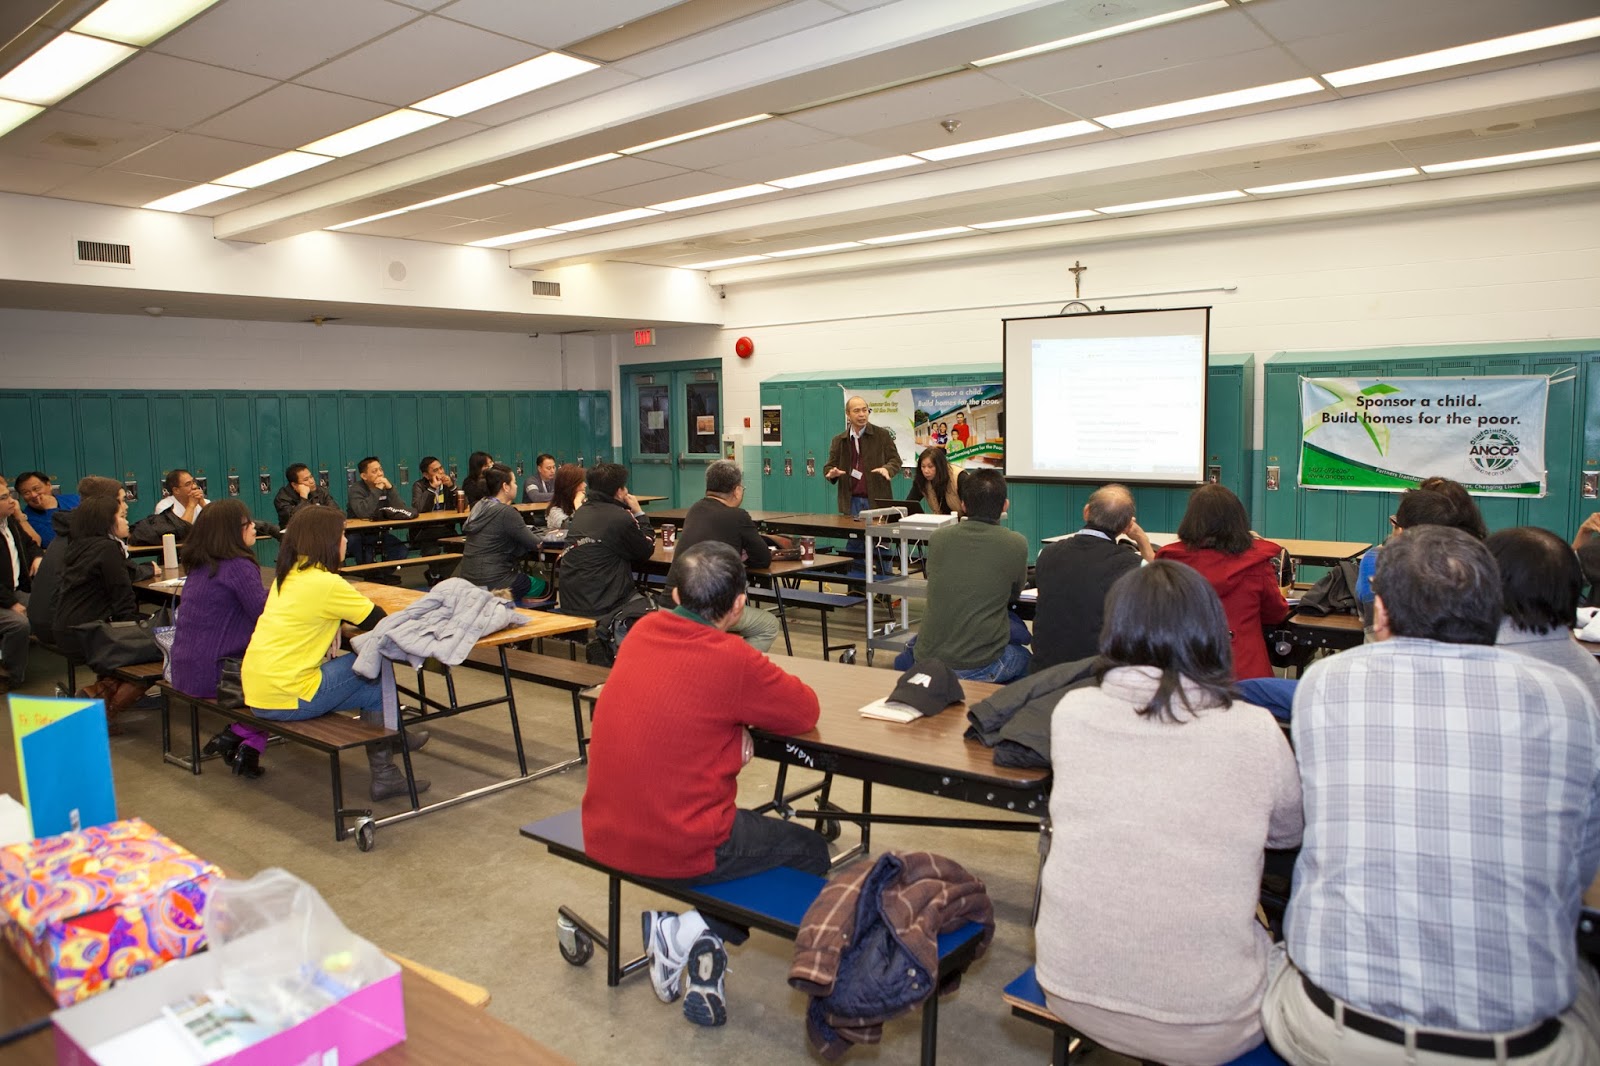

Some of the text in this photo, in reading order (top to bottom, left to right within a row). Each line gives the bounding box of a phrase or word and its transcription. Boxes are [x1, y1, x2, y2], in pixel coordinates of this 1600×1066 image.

[635, 330, 651, 345] EXIT
[931, 390, 957, 398] Sponsor
[1356, 395, 1482, 410] Sponsor a child.
[1322, 412, 1521, 428] Build homes for the poor.
[1469, 445, 1519, 456] ANCOP
